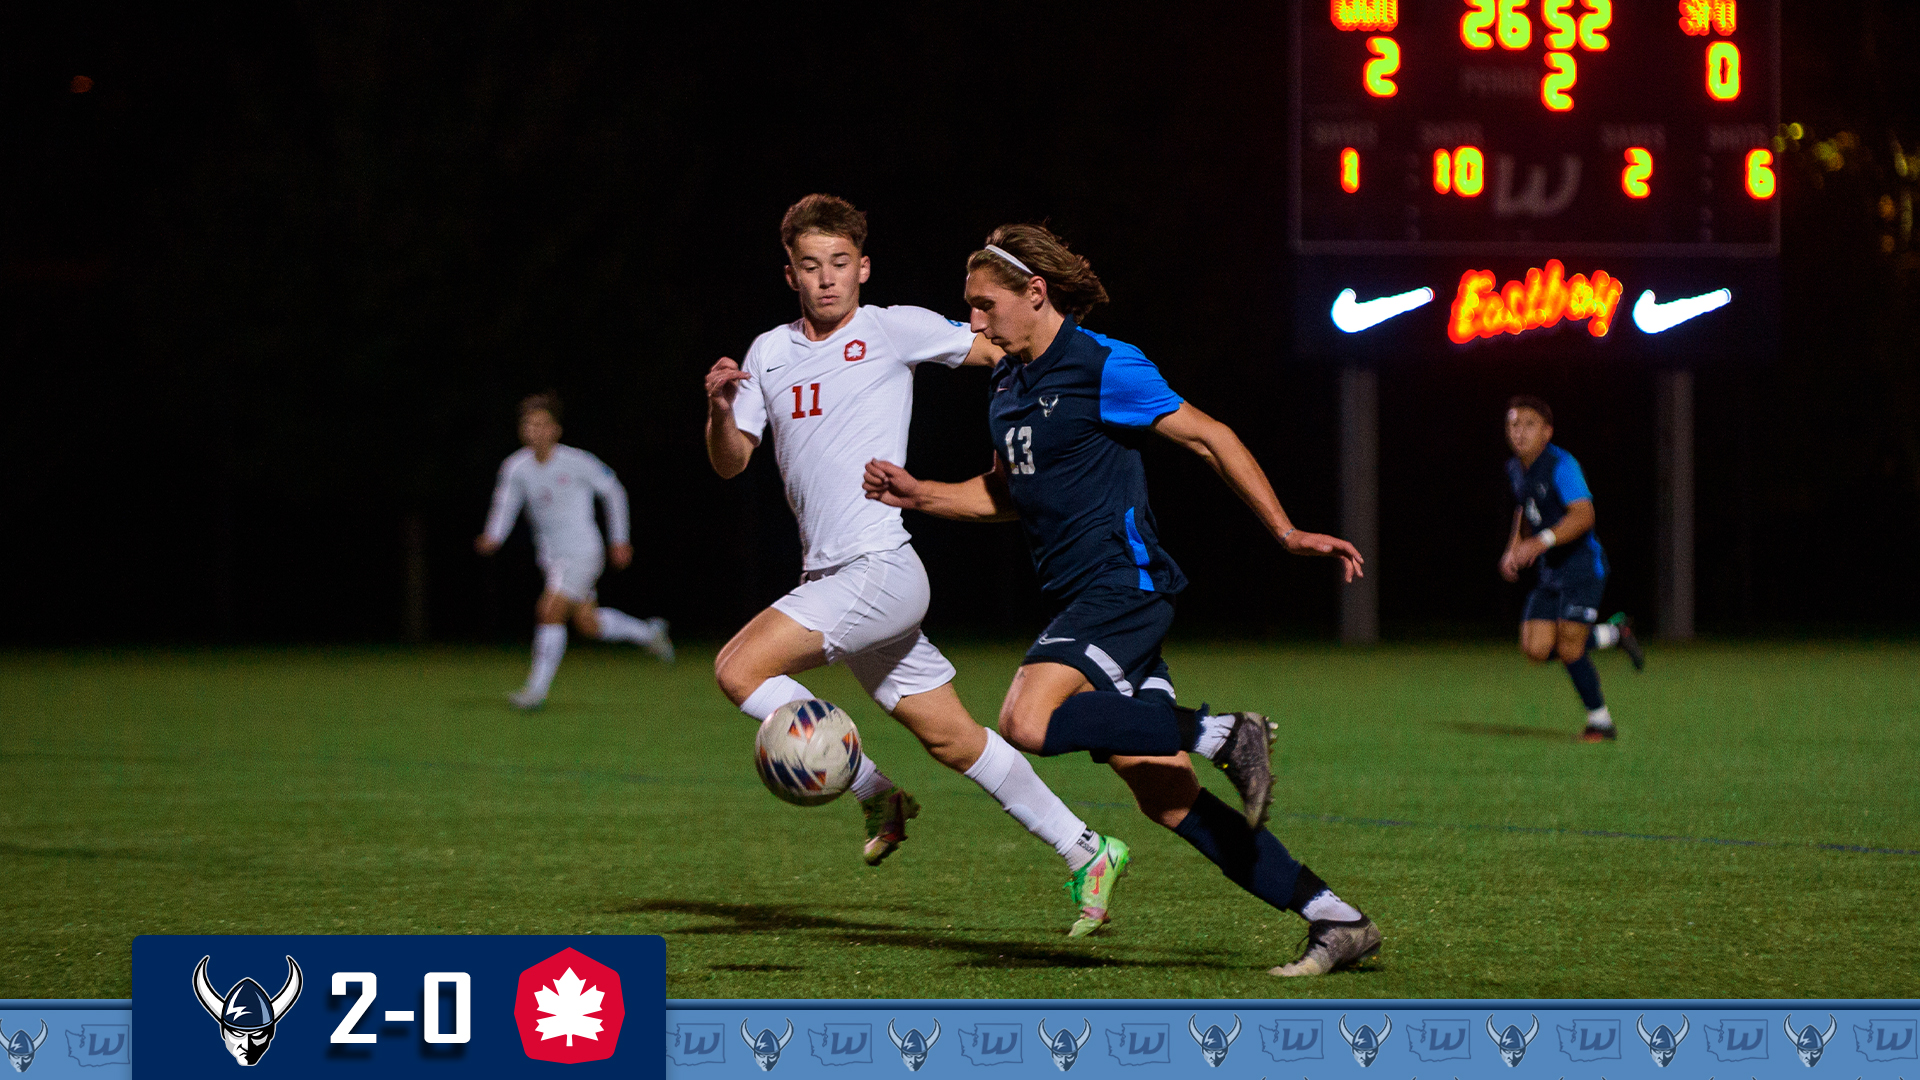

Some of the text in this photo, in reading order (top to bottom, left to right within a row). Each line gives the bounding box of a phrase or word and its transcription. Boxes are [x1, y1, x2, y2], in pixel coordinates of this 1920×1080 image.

[1363, 36, 1401, 98] 2
[1540, 51, 1578, 112] 2
[1705, 40, 1742, 101] 0
[1340, 146, 1361, 194] 1
[1433, 145, 1485, 198] 10
[1621, 147, 1654, 199] 2
[1745, 148, 1777, 200] 6
[791, 382, 823, 419] 11
[1005, 425, 1036, 475] 13
